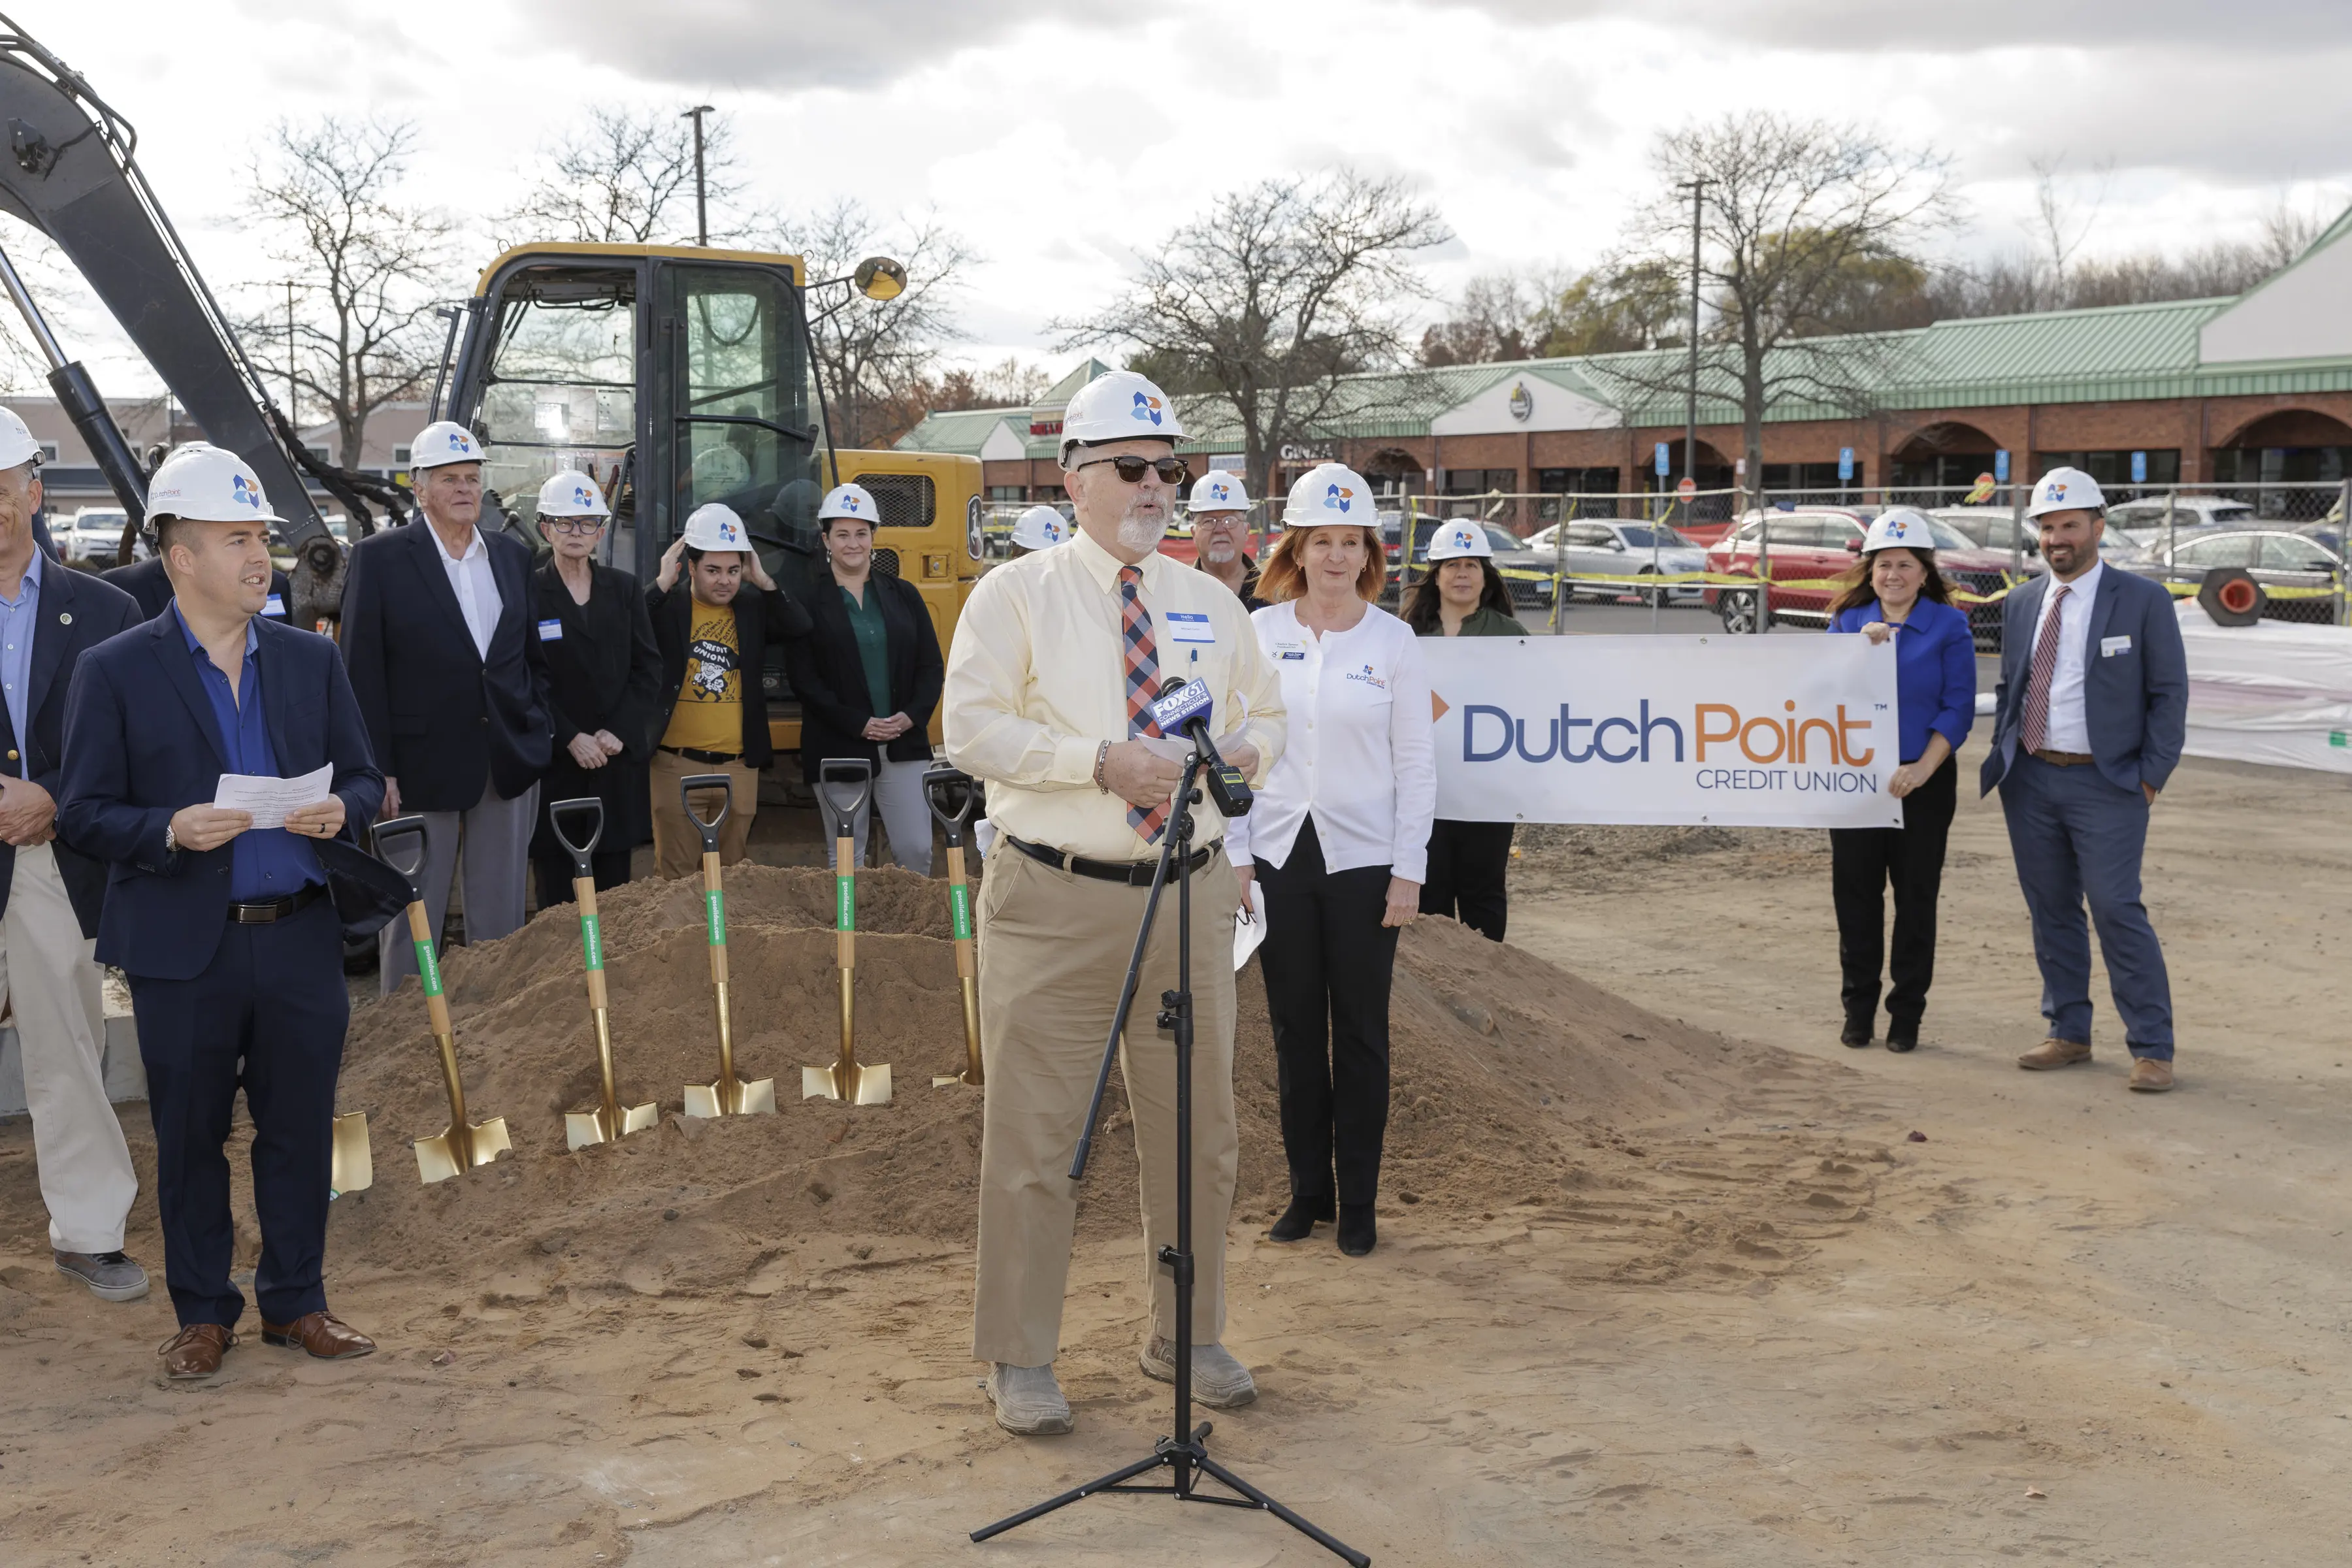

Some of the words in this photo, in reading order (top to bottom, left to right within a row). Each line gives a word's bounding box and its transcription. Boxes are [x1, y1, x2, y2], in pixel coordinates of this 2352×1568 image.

[693, 645, 725, 663] UNION
[702, 641, 727, 654] CREDIT
[1158, 692, 1207, 722] CONNECTICUT'S
[1160, 713, 1181, 727] NEWS
[1181, 696, 1210, 715] STATION
[1463, 698, 1684, 764] Dutch
[1695, 699, 1875, 768] Point
[1696, 769, 1788, 791] CREDIT
[1793, 770, 1878, 794] UNION
[711, 895, 720, 940] gosolidus.com
[841, 881, 850, 926] gosolidus.com
[956, 890, 966, 934] gosolidus.com
[586, 920, 596, 965] gosolidus.com
[423, 945, 438, 991] gosolidus.com
